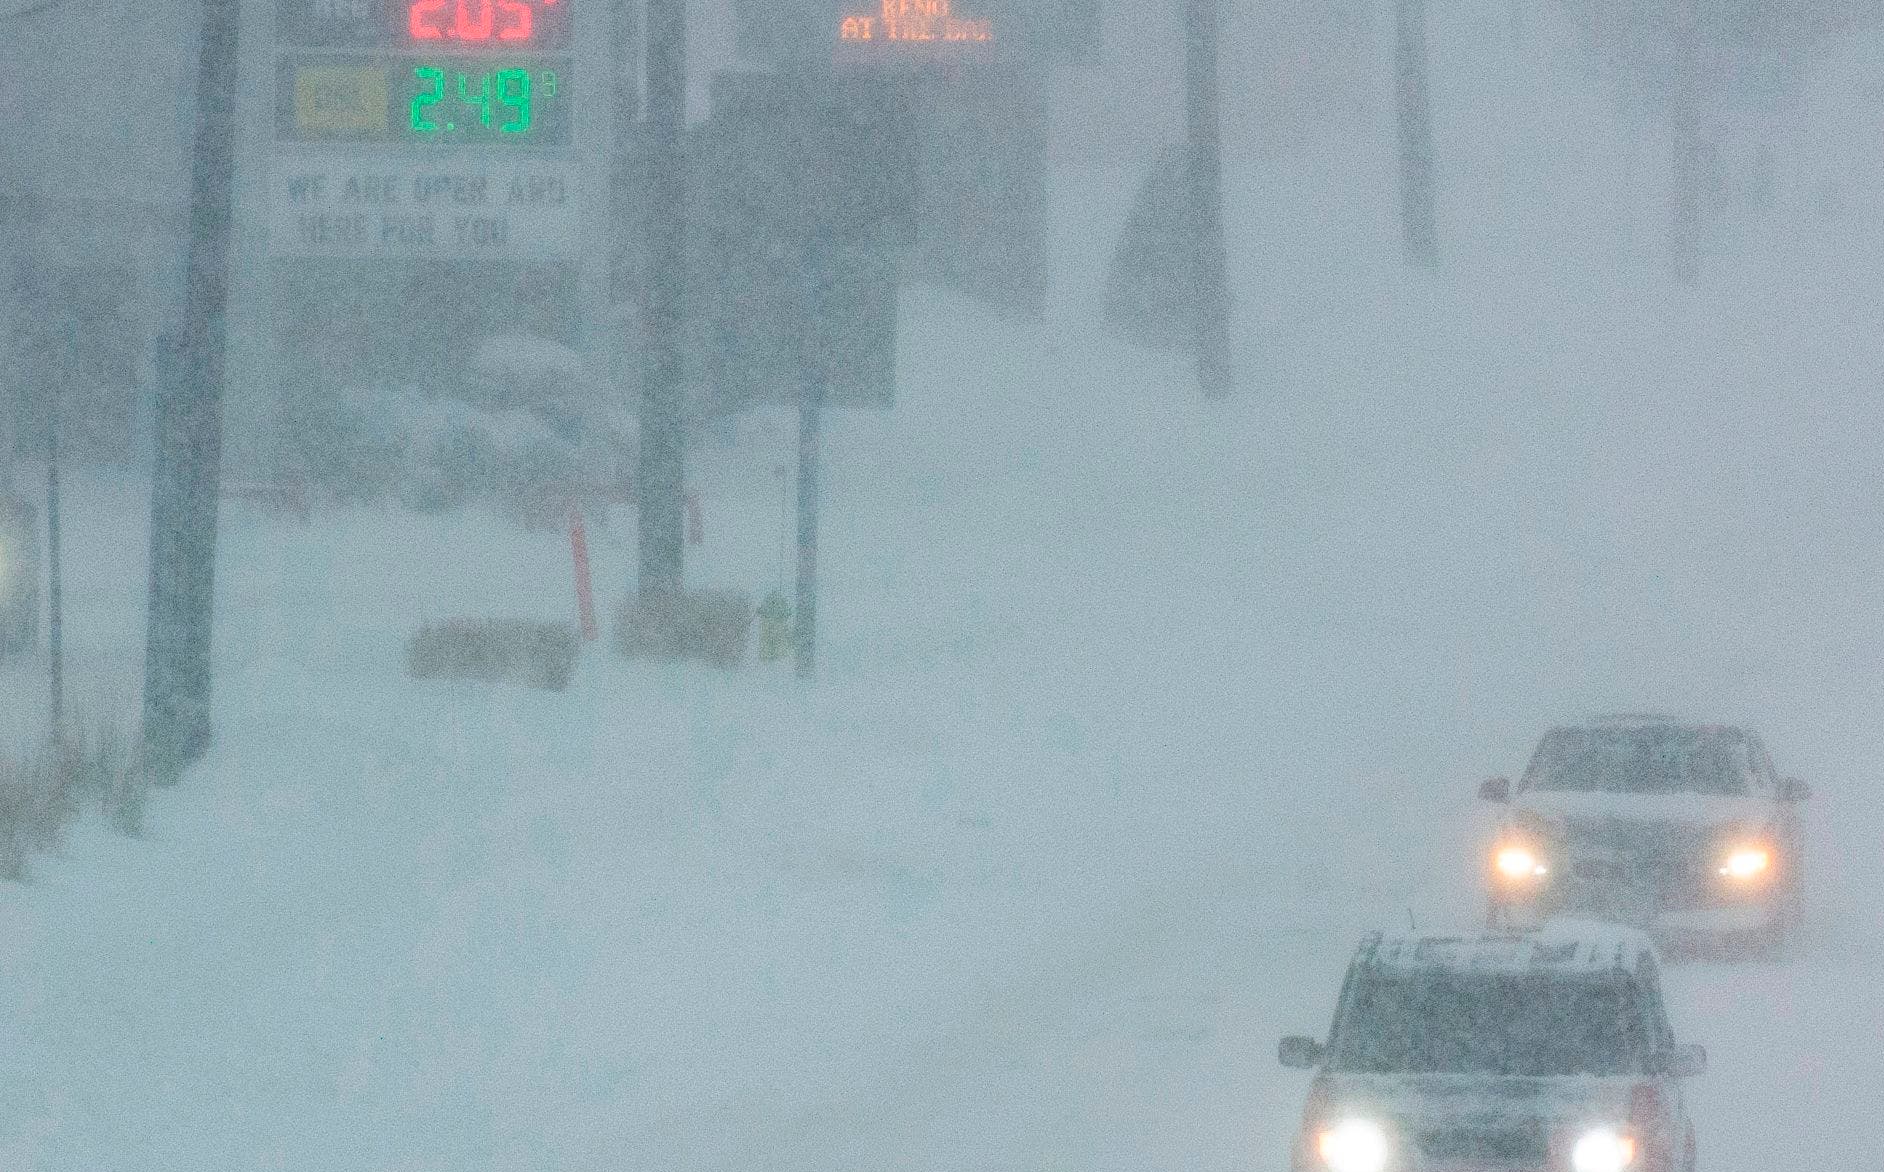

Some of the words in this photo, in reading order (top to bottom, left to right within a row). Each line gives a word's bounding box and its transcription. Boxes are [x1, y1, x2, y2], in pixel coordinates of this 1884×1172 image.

[410, 66, 532, 132] 2.49
[286, 175, 327, 204] WE
[341, 175, 400, 205] ARE
[413, 175, 489, 205] OPEN
[506, 175, 568, 205] AND
[297, 215, 368, 245] HERE
[381, 215, 436, 245] FOR
[454, 215, 510, 246] YOU
